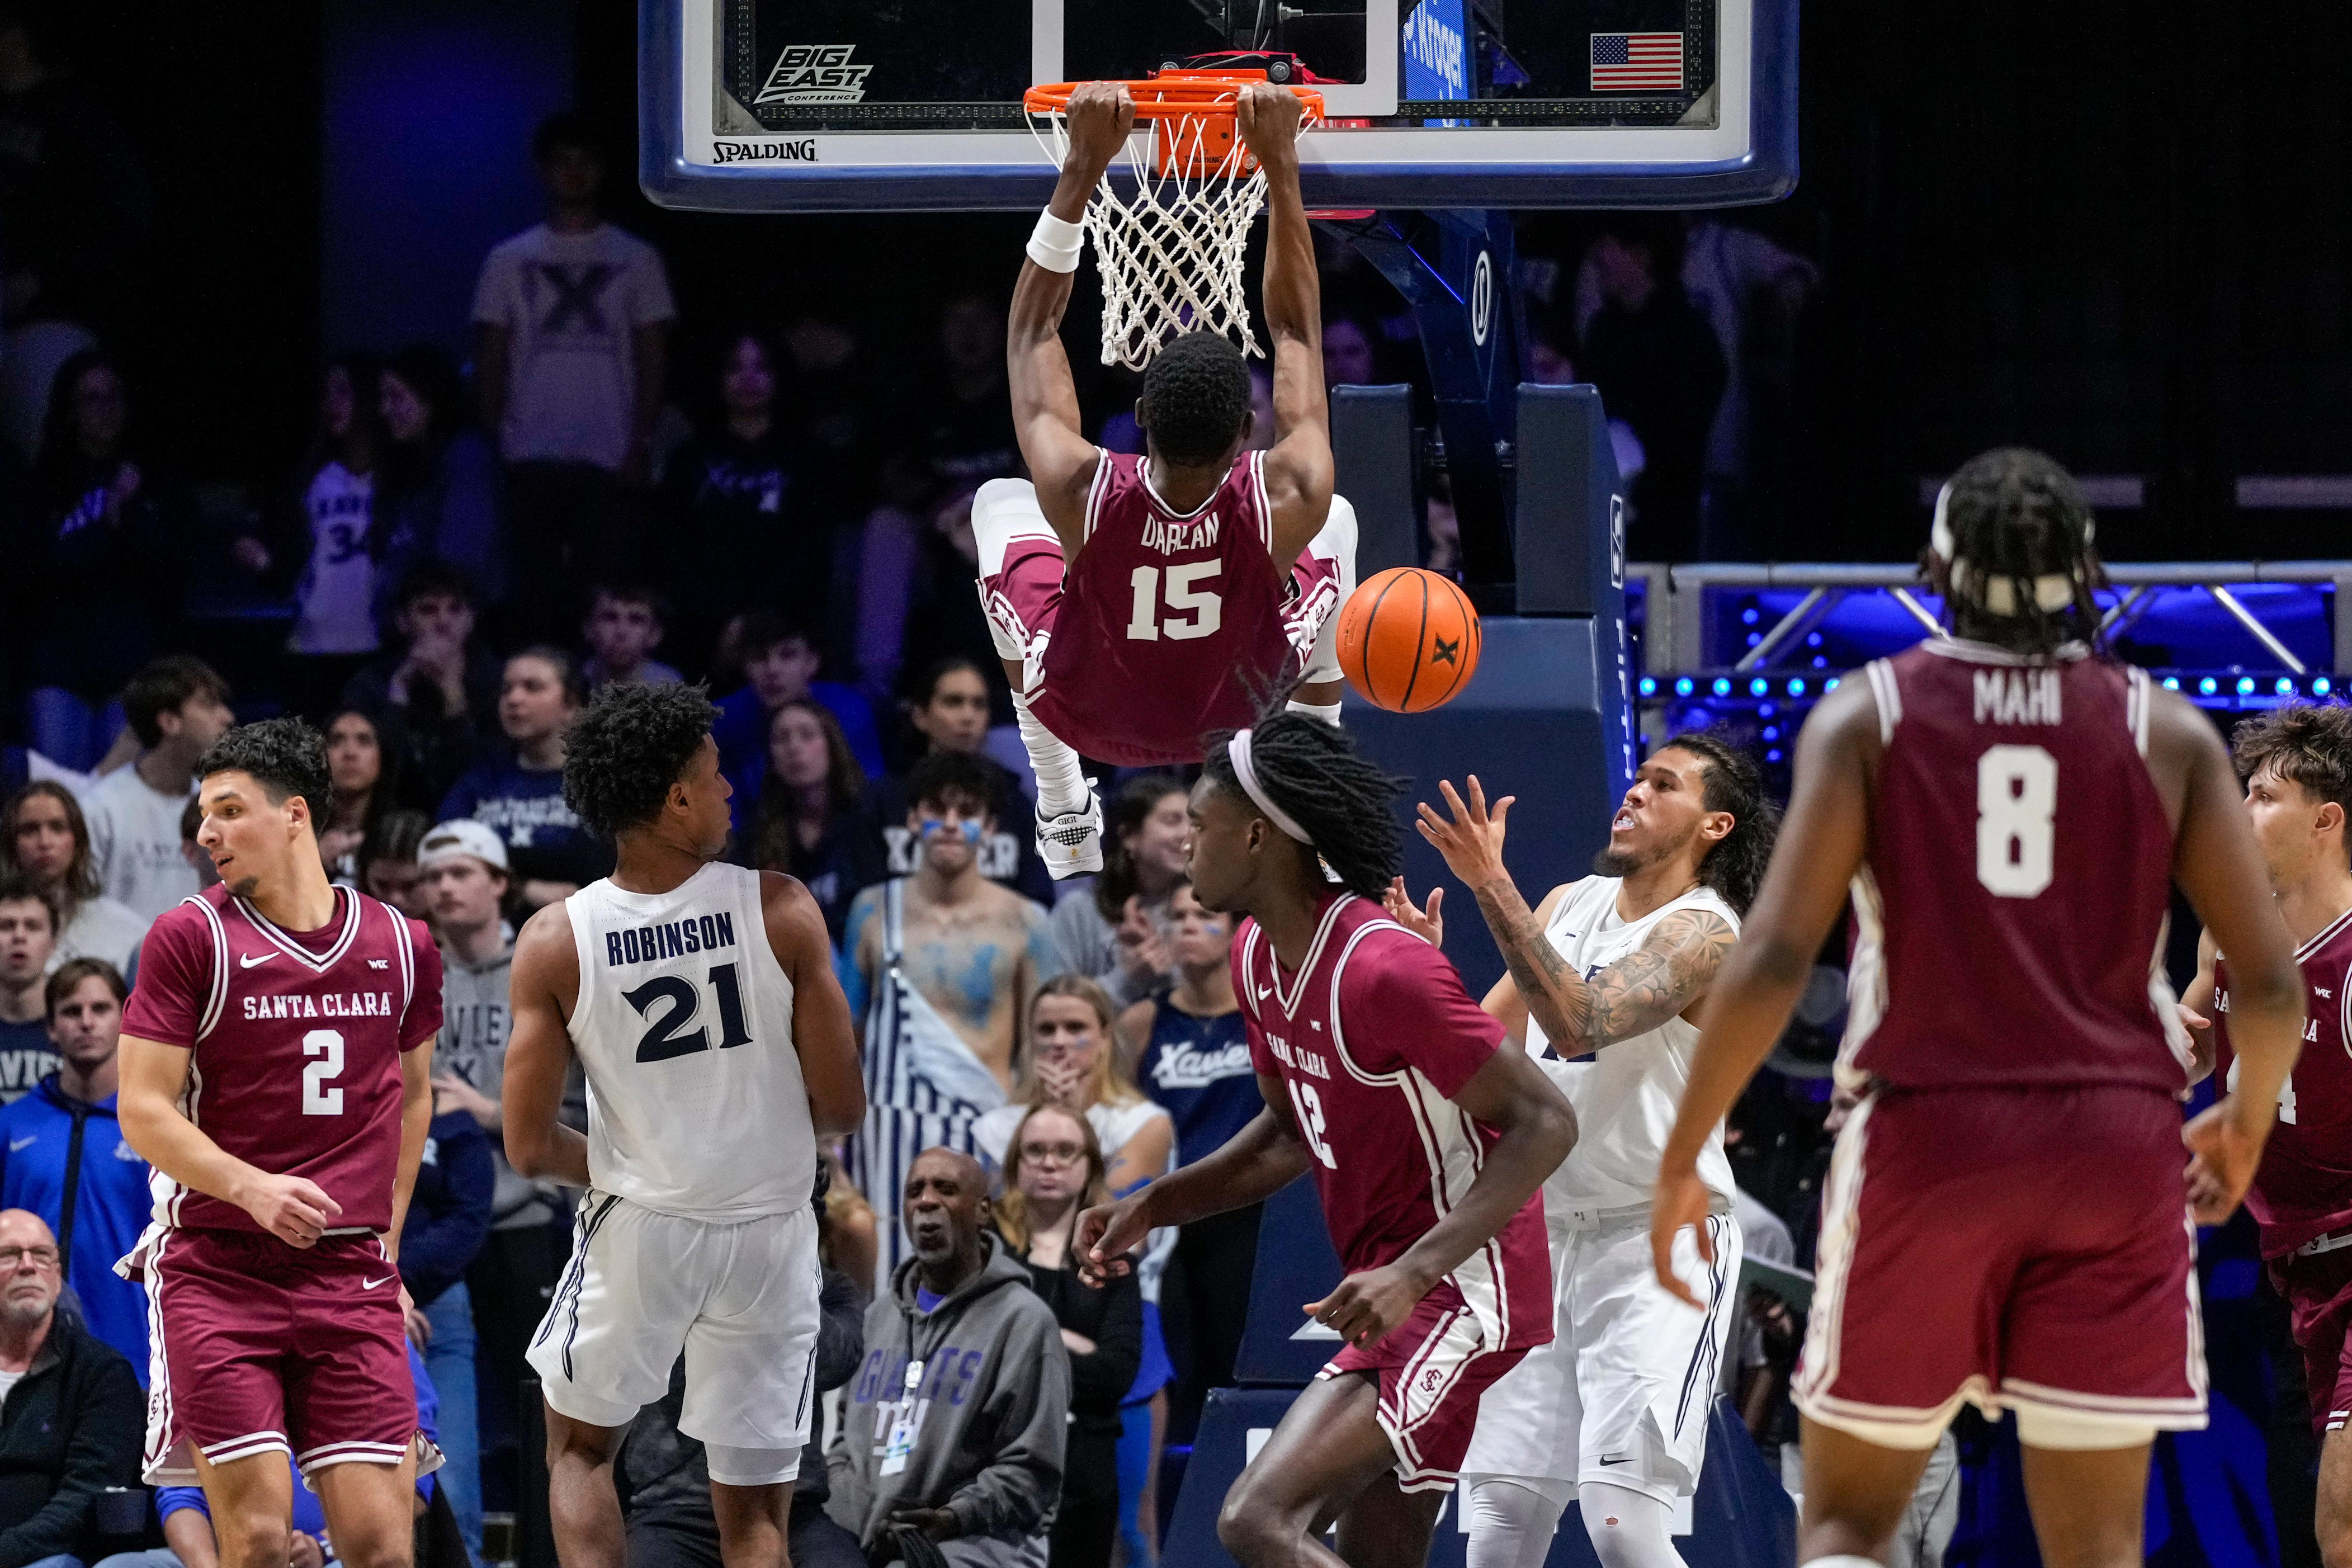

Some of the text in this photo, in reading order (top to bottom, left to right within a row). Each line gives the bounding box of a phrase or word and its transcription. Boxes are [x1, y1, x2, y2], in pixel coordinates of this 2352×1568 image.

[768, 69, 867, 87] EAST
[778, 48, 849, 68] BIG
[714, 139, 815, 164] SPALDING
[1141, 512, 1220, 556] DARLAN
[1127, 558, 1222, 641] 15
[1973, 668, 2062, 726] MAHI
[1058, 816, 1077, 825] GIGI
[1976, 743, 2060, 899] 8
[606, 912, 735, 966] ROBINSON
[243, 992, 392, 1020] SANTA CLARA
[621, 962, 753, 1063] 21
[302, 1029, 344, 1116] 2
[1289, 1079, 1338, 1169] 12
